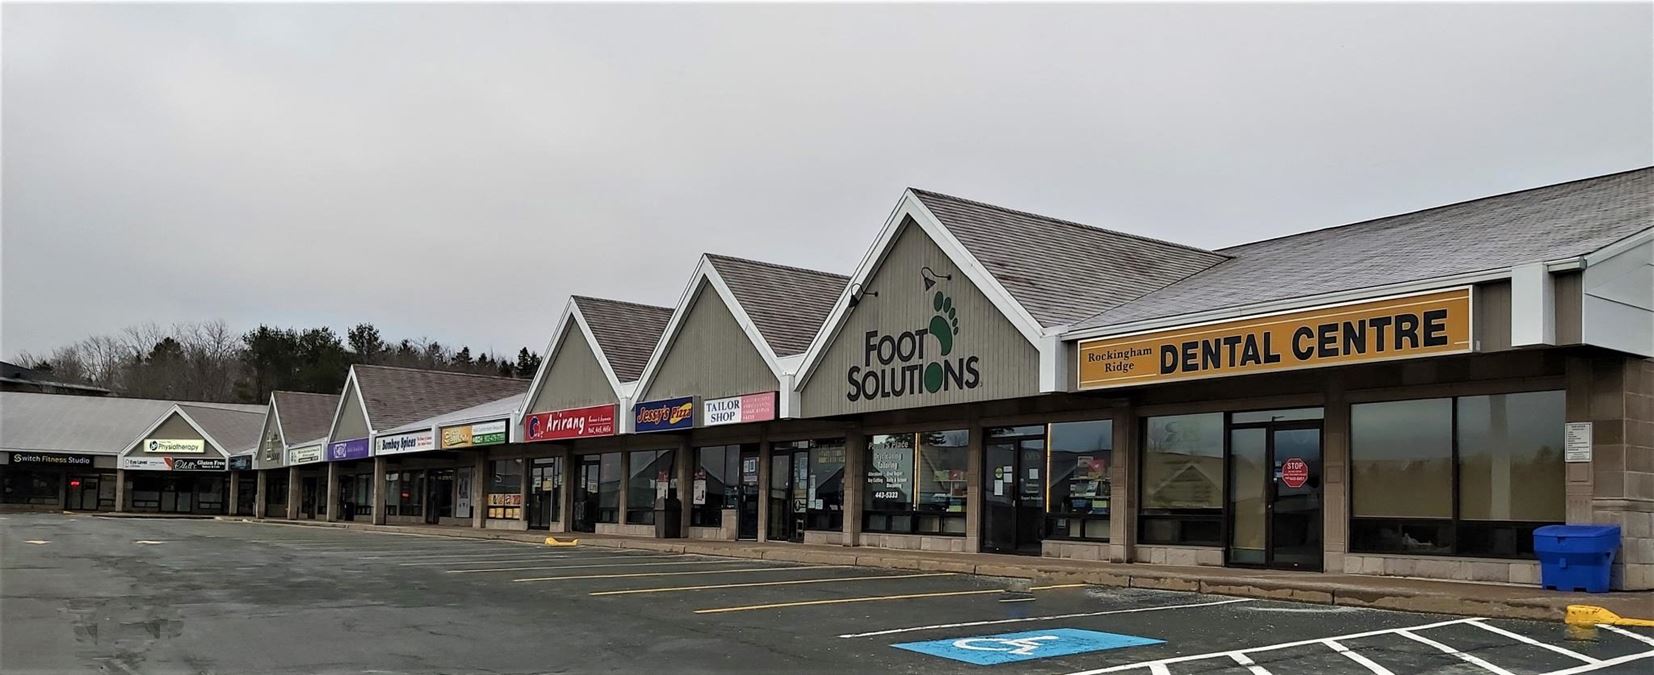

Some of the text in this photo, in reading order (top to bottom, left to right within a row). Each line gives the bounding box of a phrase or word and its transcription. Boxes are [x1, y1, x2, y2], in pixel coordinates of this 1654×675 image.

[865, 328, 928, 367] FOOT
[1160, 308, 1448, 375] DENTAL CENTRE
[1088, 346, 1152, 364] Rockingham
[1104, 360, 1135, 374] Ridge
[846, 356, 980, 402] SOLUTIONS
[706, 399, 740, 412] TAILOR
[637, 404, 692, 424] Jessy's Pizza
[711, 412, 735, 423] SHOP
[546, 412, 585, 434] Arirang
[158, 442, 199, 451] Physiotherapy
[382, 436, 416, 451] Bombay Spices
[14, 453, 40, 463] Switch
[68, 456, 90, 464] Studio
[1287, 462, 1303, 470] STOP
